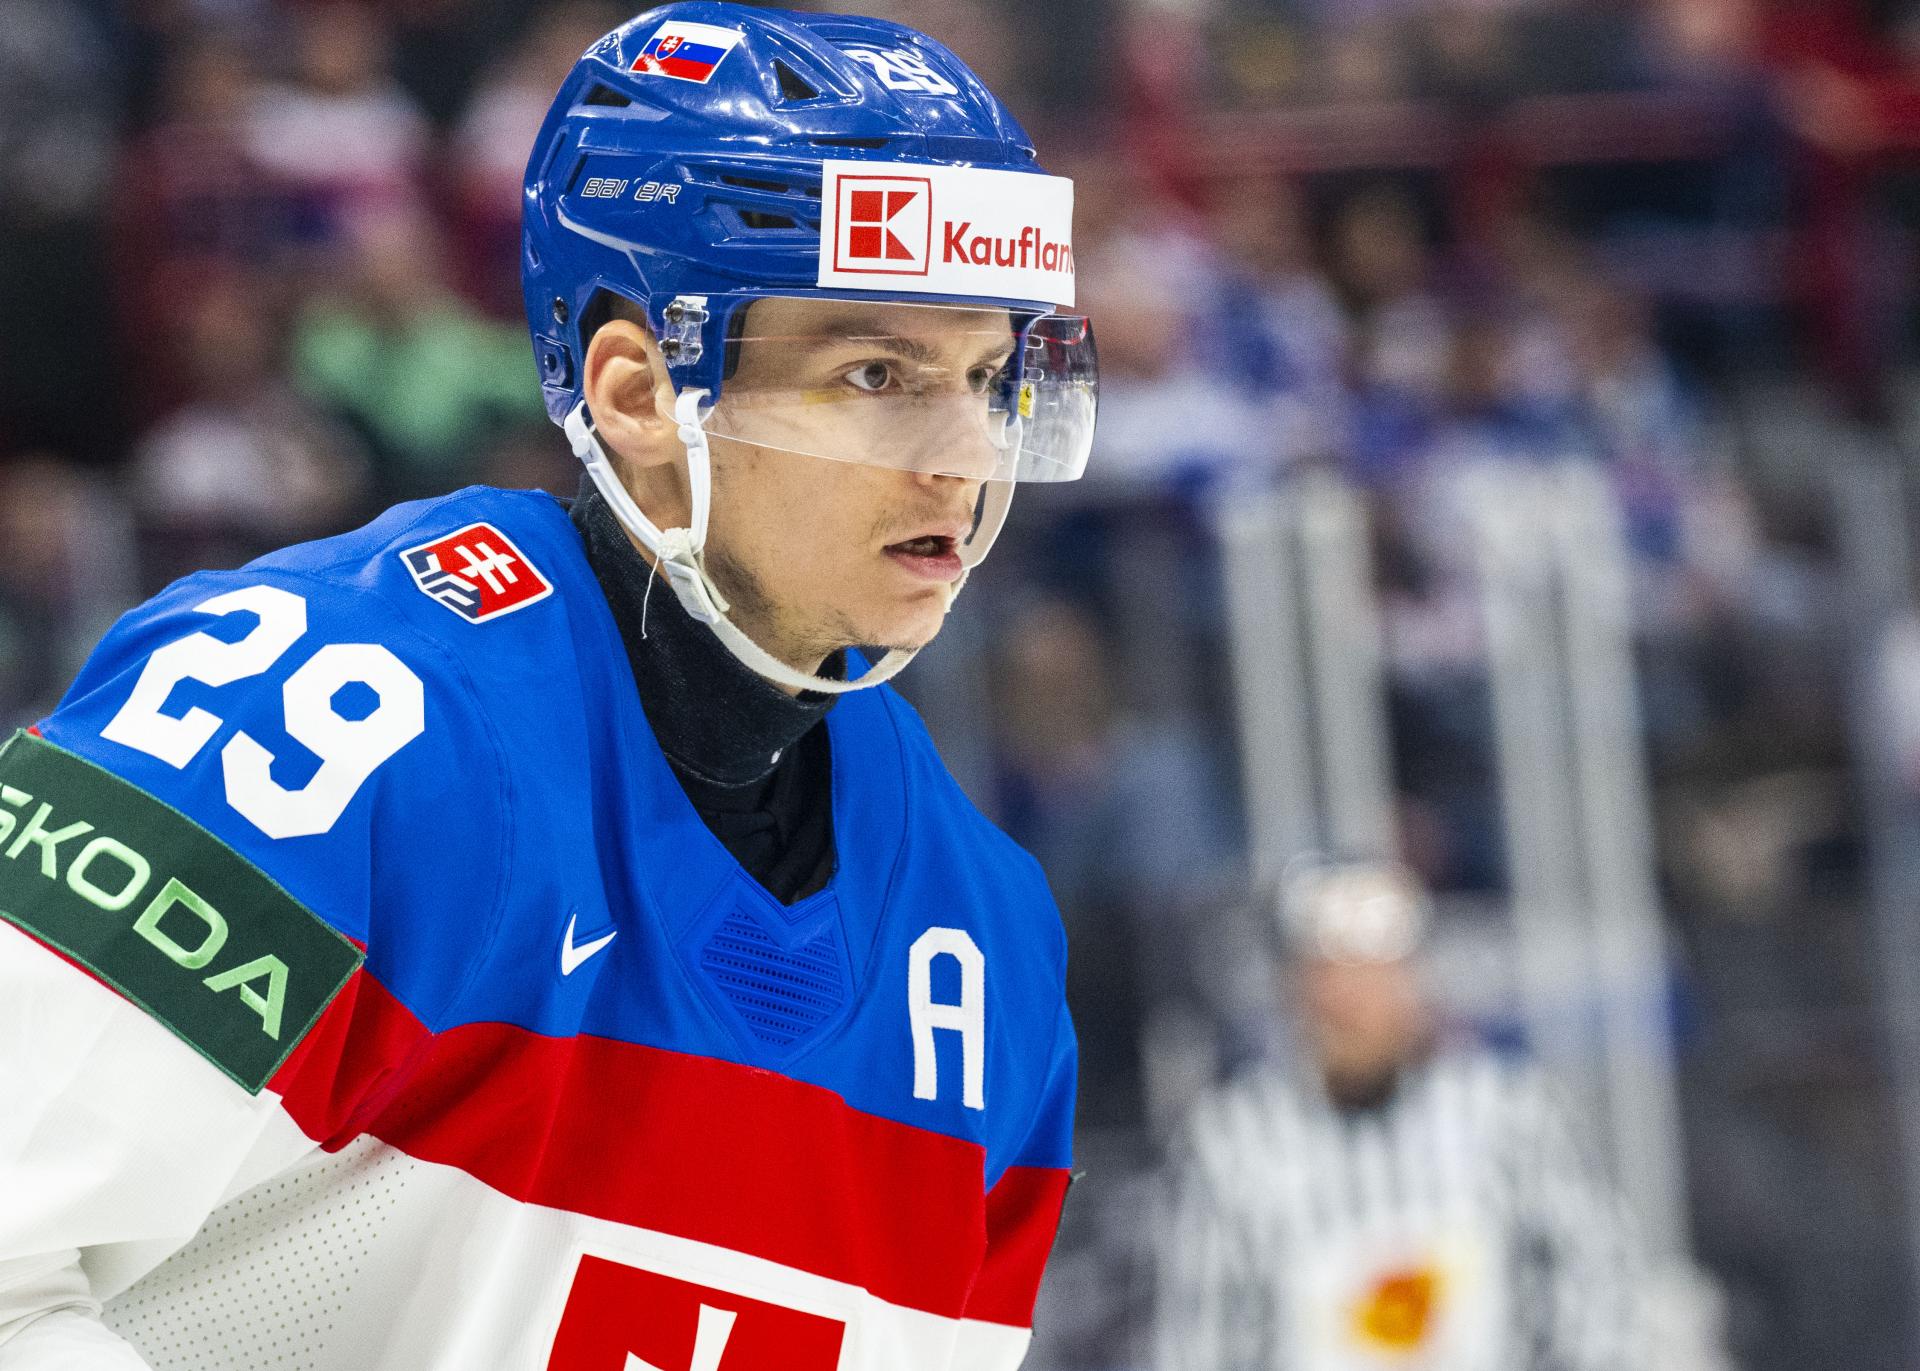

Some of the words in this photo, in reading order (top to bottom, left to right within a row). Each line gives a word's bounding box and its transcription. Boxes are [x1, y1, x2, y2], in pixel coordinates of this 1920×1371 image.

[841, 48, 959, 95] 29
[943, 221, 1074, 275] Kauflan
[99, 584, 425, 840] 29
[908, 927, 985, 1110] A
